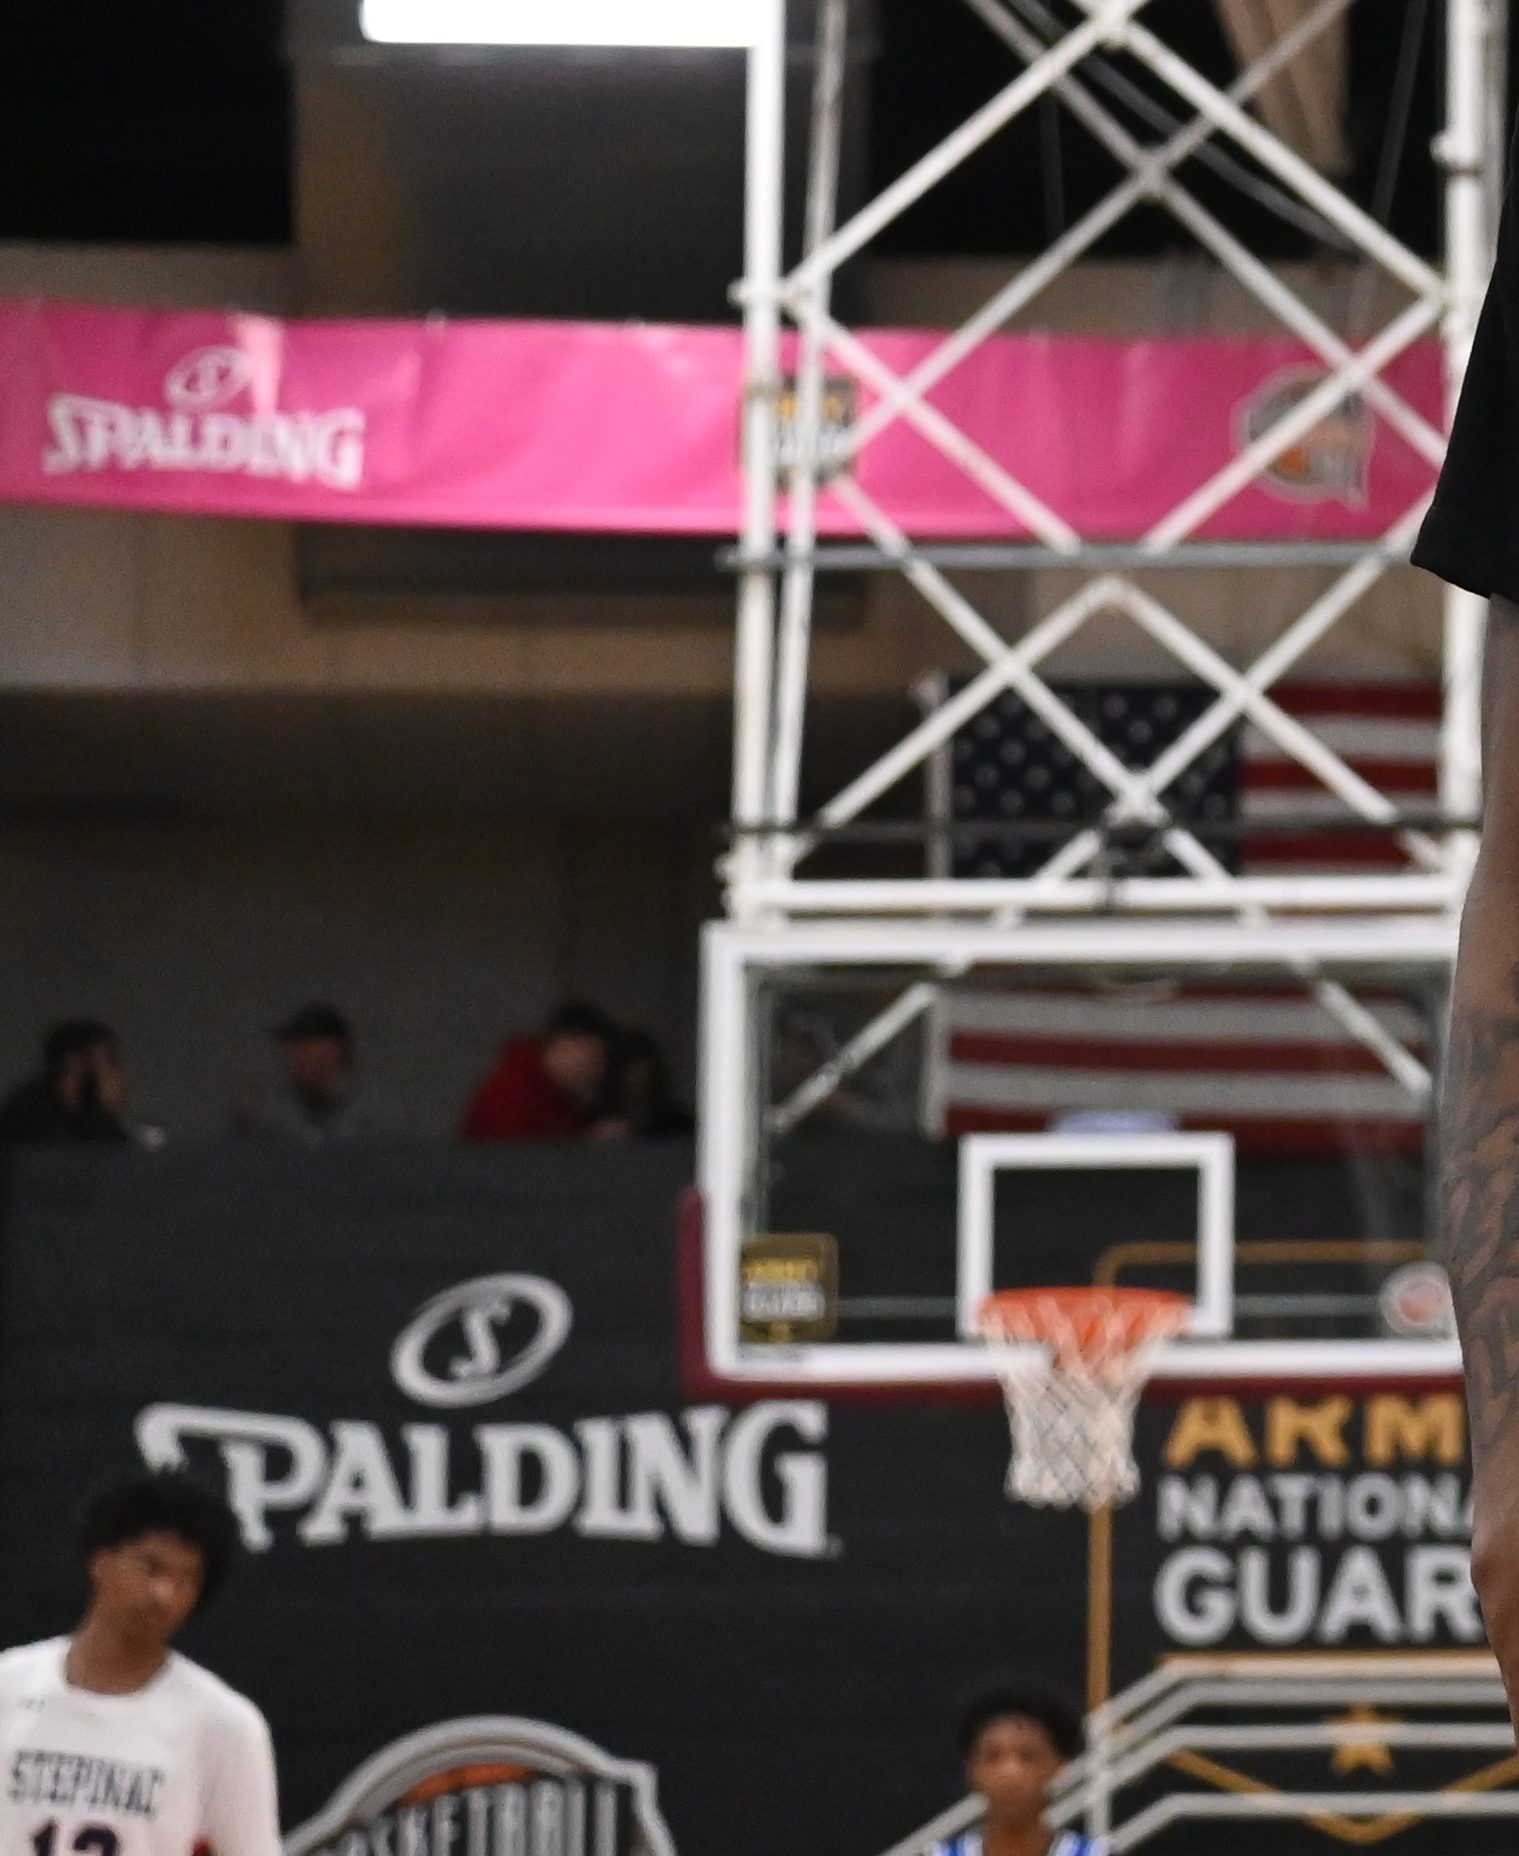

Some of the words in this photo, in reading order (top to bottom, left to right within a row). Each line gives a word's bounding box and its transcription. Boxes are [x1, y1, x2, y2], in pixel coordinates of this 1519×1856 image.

[42, 393, 366, 491] SPALDING
[1163, 1394, 1466, 1469] ARM
[1154, 1473, 1475, 1541] NATION
[1152, 1544, 1488, 1645] GUAR
